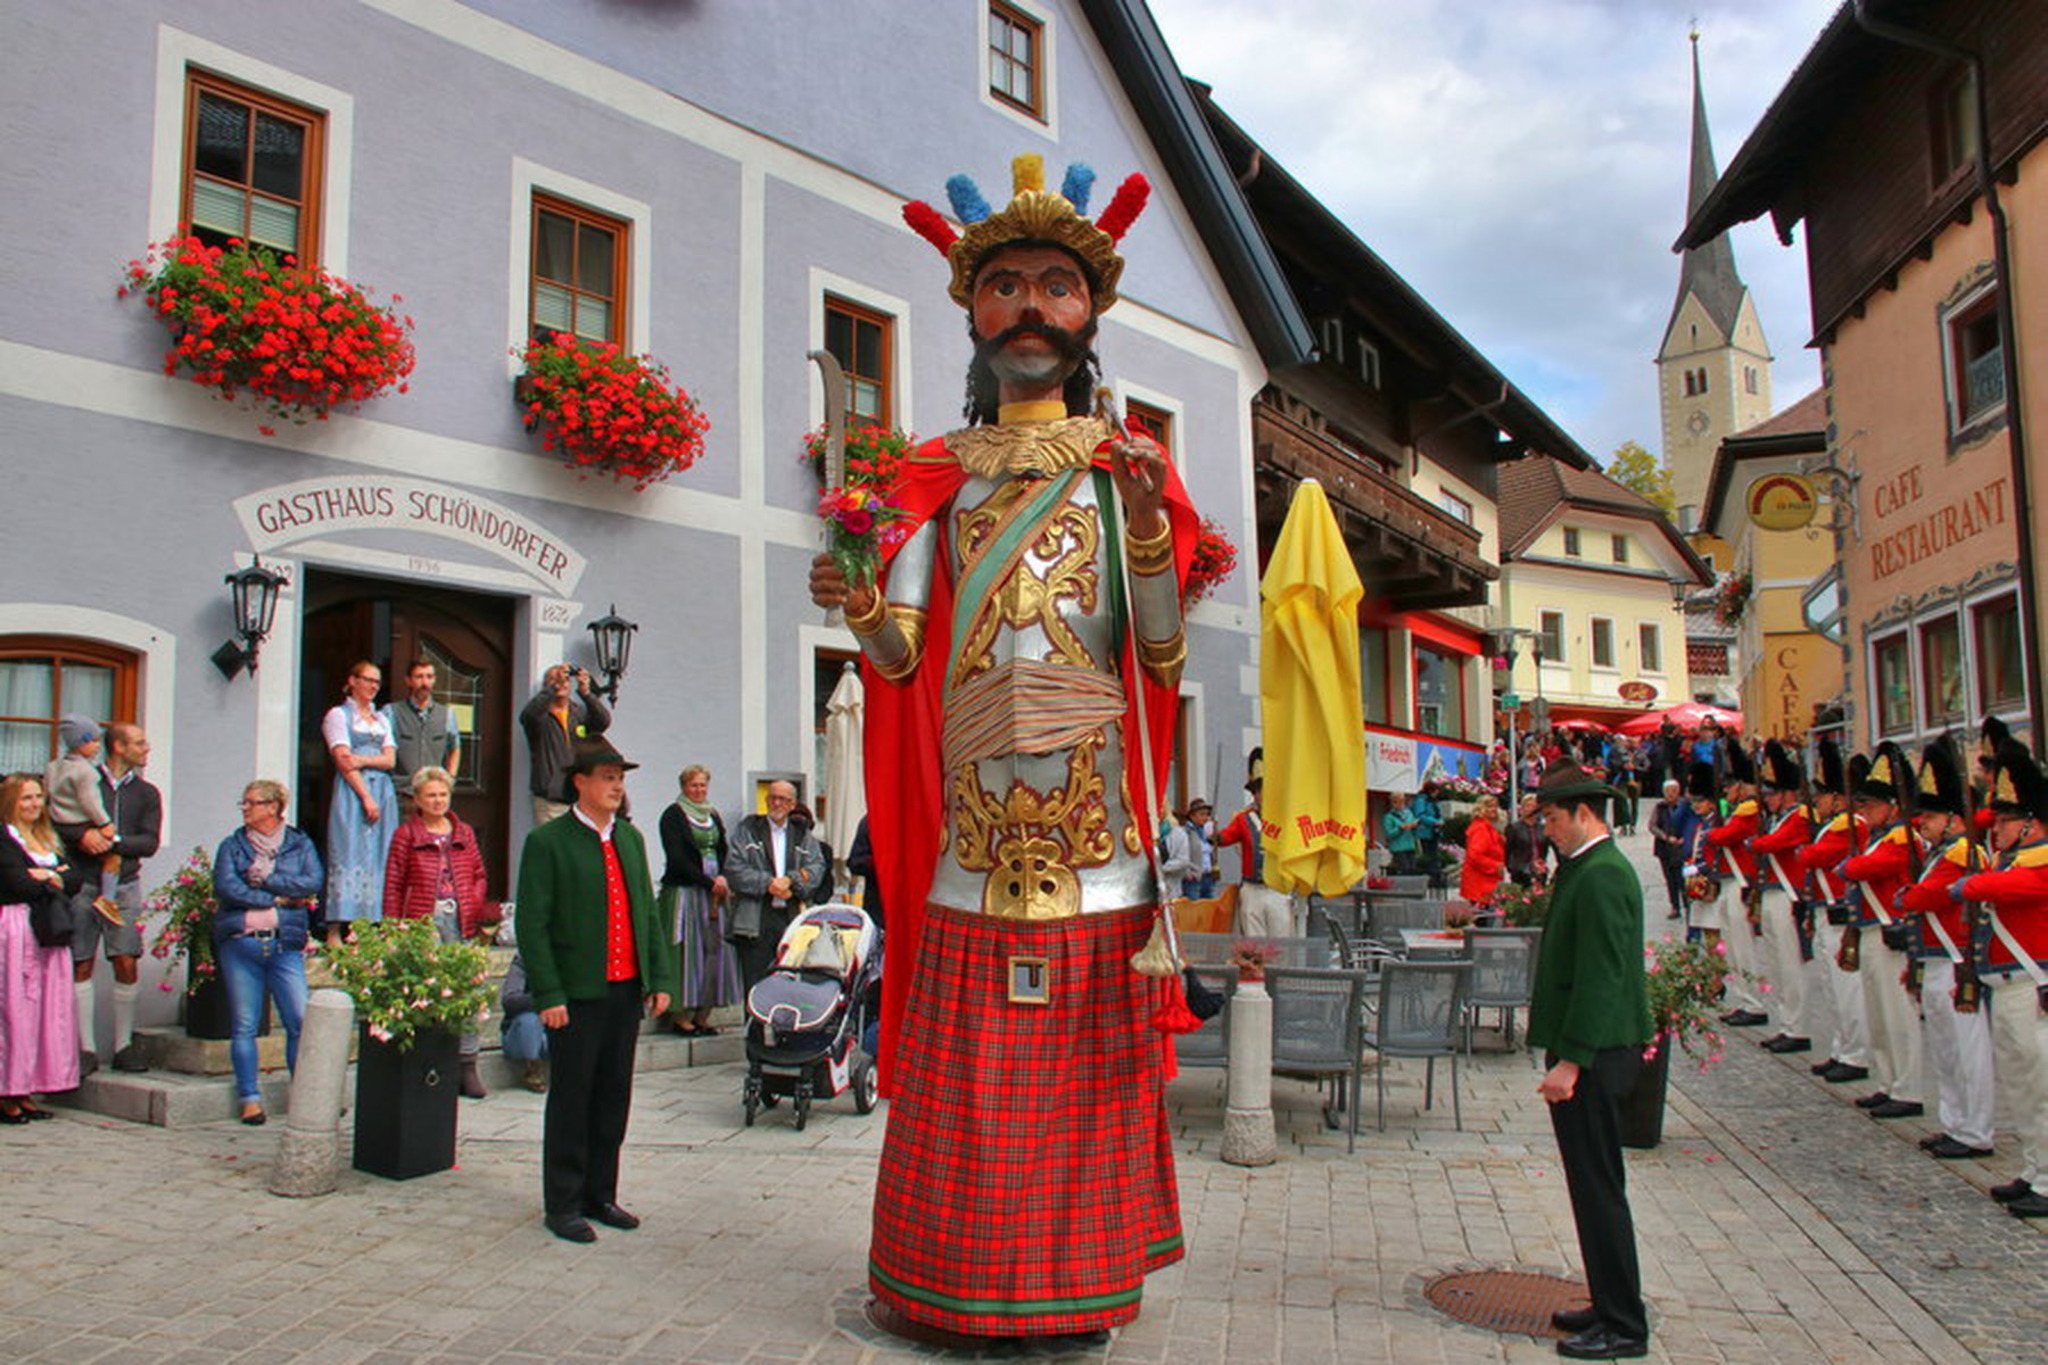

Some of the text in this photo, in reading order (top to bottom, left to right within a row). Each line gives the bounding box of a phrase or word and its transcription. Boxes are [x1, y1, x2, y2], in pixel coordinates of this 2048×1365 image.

[256, 487, 568, 581] GASTHAUS SCHÖNDORFER
[1871, 477, 2007, 582] RESTAURANT
[1874, 464, 1923, 519] CAFE
